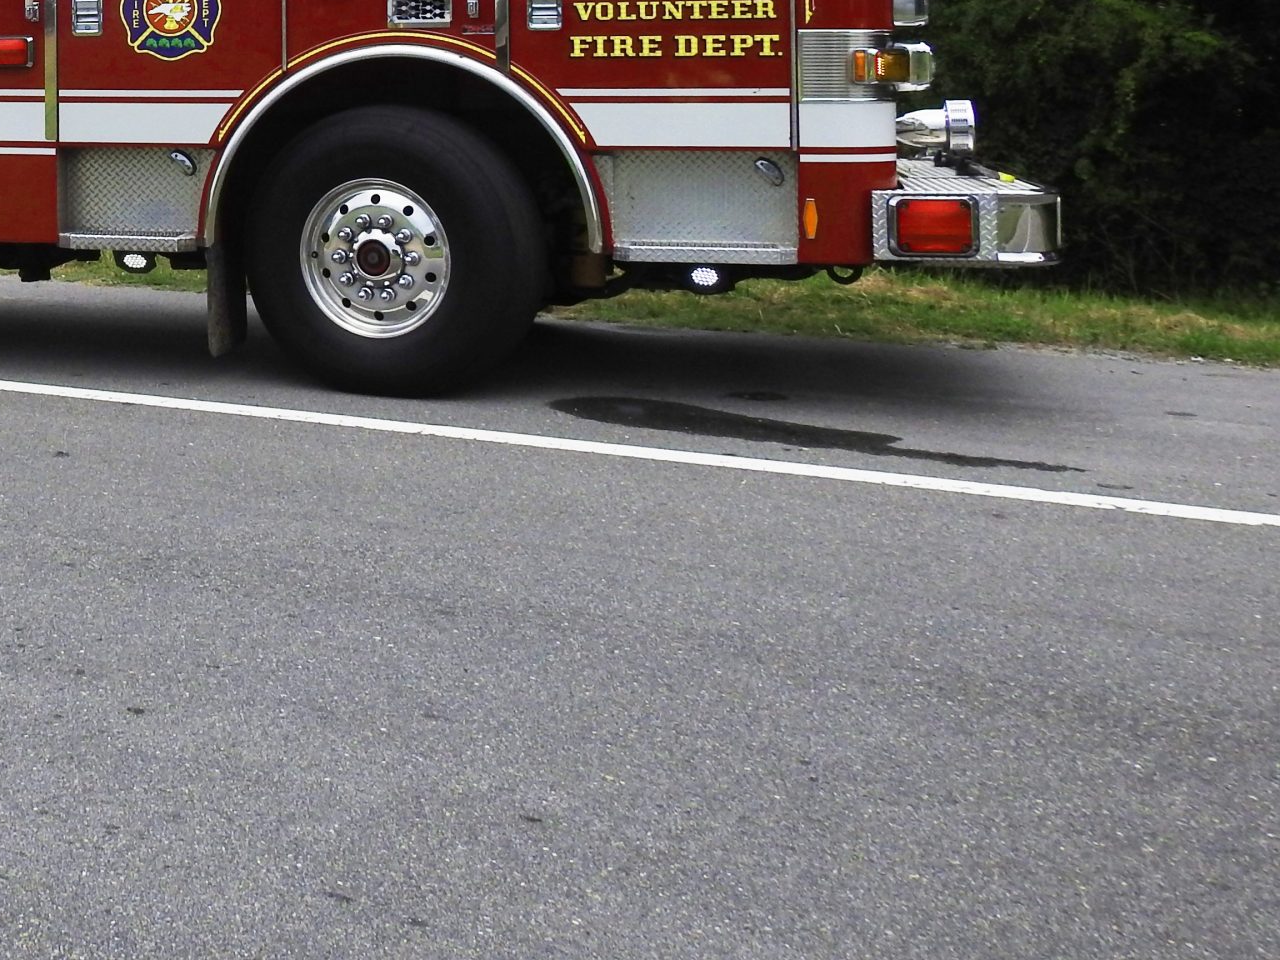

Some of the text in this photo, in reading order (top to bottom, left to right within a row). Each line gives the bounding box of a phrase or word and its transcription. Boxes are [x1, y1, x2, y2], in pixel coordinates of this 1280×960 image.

[573, 0, 777, 21] VOLUNTEER
[570, 34, 783, 57] FIRE DEPT.
